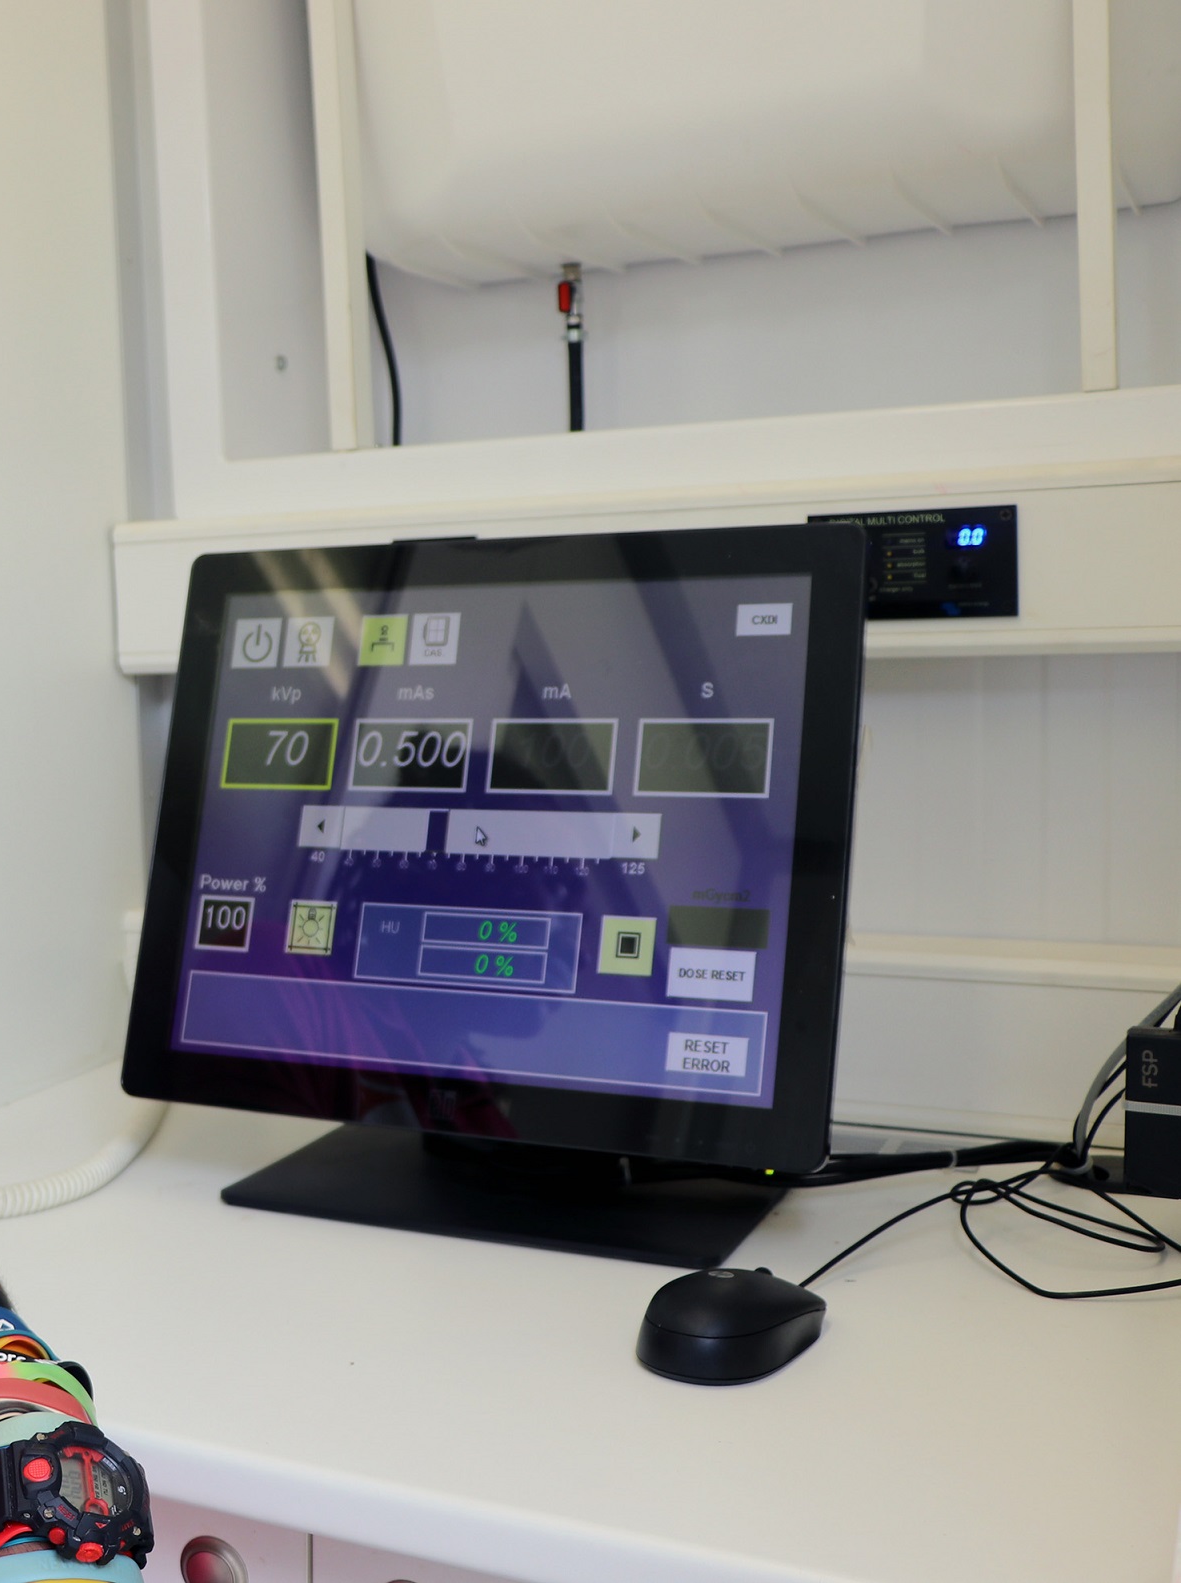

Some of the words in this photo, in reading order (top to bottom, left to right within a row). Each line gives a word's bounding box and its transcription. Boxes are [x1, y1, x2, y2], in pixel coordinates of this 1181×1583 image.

[868, 515, 896, 526] MULTI
[898, 513, 946, 525] CONTROL
[271, 685, 302, 705] kVp
[397, 684, 435, 701] mAs
[542, 683, 573, 700] mA
[701, 681, 715, 699] S
[265, 730, 310, 766] 70
[357, 730, 467, 768] 0.500
[310, 851, 326, 863] 40
[621, 861, 646, 876] 125
[200, 873, 249, 892] Power
[253, 876, 267, 893] %
[204, 905, 247, 931] 100
[380, 920, 400, 934] HU
[478, 920, 493, 941] 0
[499, 920, 518, 943] %
[474, 953, 489, 975] 0
[494, 954, 514, 977] %
[678, 967, 708, 980] DOSE
[711, 969, 746, 982] RESET
[683, 1038, 730, 1055] RESET
[682, 1057, 731, 1074] ERROR
[1141, 1049, 1159, 1089] FSP
